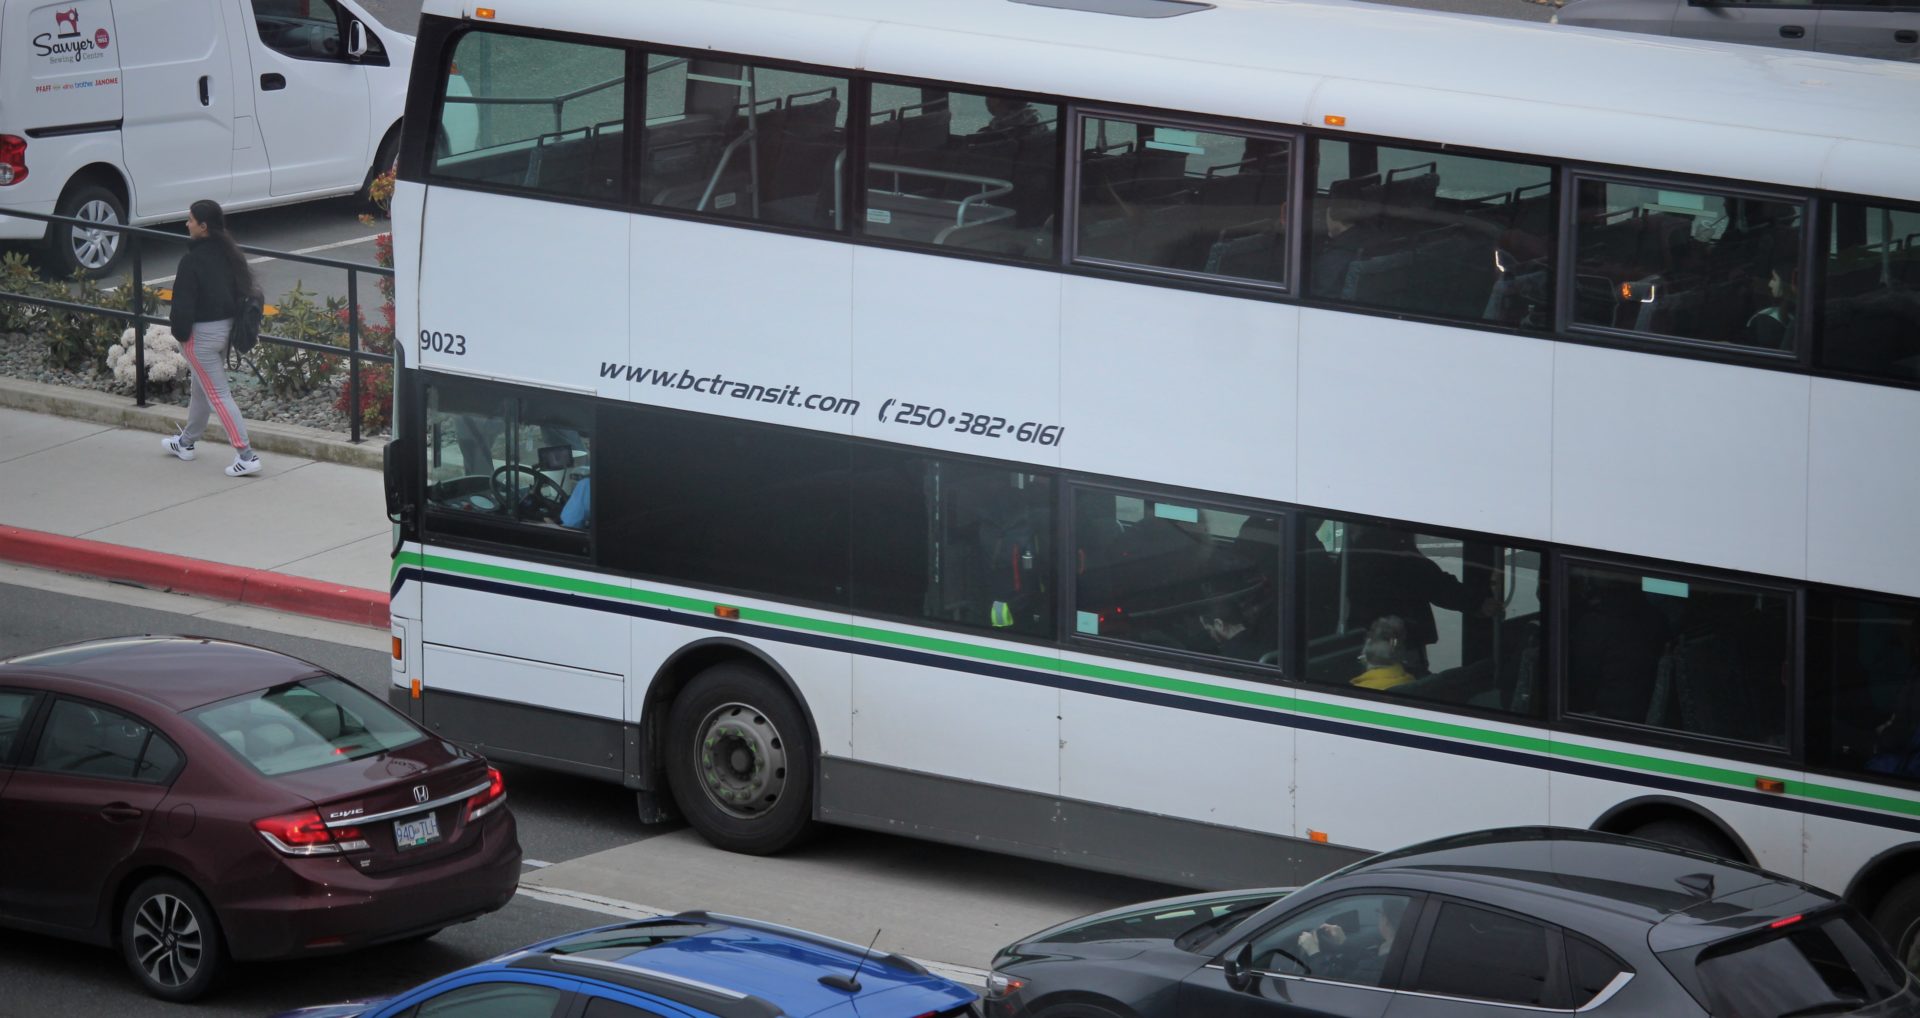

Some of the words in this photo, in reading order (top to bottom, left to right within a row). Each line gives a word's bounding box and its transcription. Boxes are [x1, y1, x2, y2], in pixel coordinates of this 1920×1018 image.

[33, 32, 95, 62] Sawyer
[36, 84, 51, 93] PFAFF
[95, 78, 118, 86] JANOME
[420, 329, 466, 356] 9023
[600, 361, 861, 416] www.bctransit.com
[330, 808, 364, 818] CIVIC
